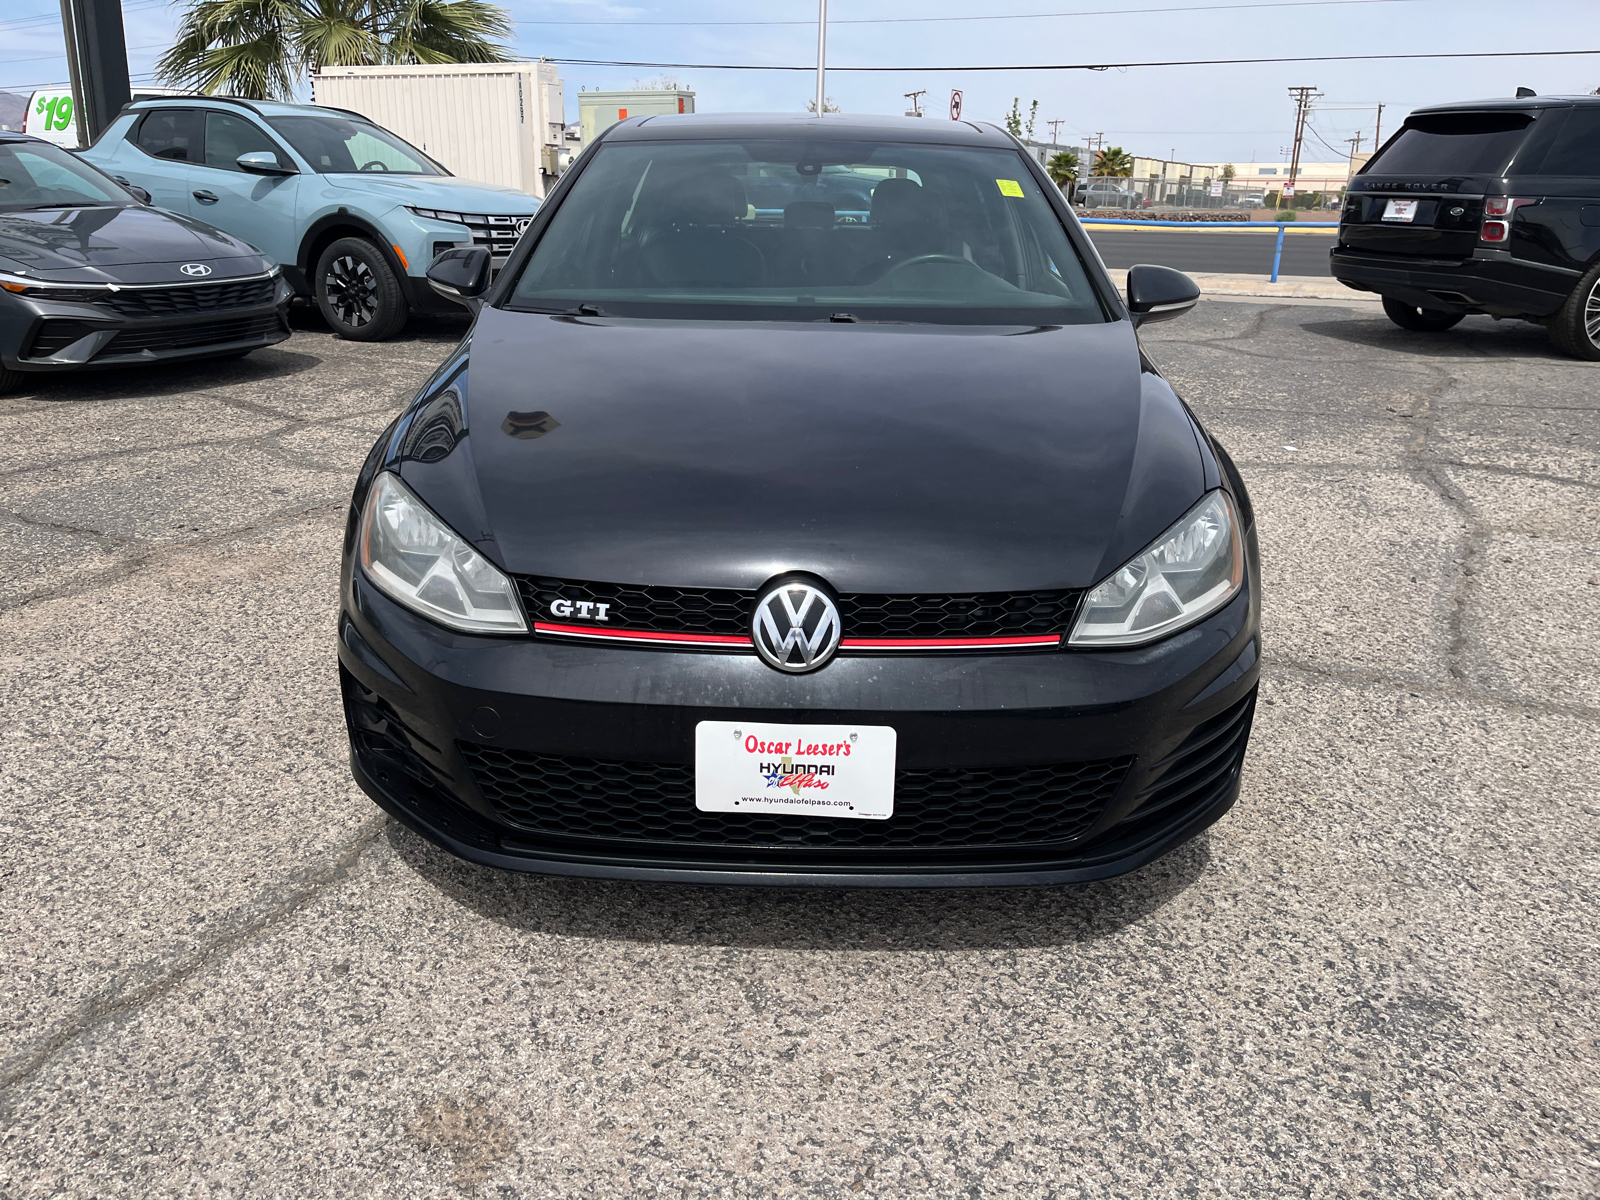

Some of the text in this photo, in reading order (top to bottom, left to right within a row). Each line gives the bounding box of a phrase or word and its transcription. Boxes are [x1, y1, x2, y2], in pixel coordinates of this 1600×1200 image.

[1363, 182, 1398, 190] RANGE
[550, 599, 610, 621] GTI
[744, 734, 851, 757] Oscar Leeser's
[759, 762, 835, 776] HYUNDAI
[768, 775, 780, 788] of
[741, 796, 851, 808] www.hyundaiofelpaso.com
